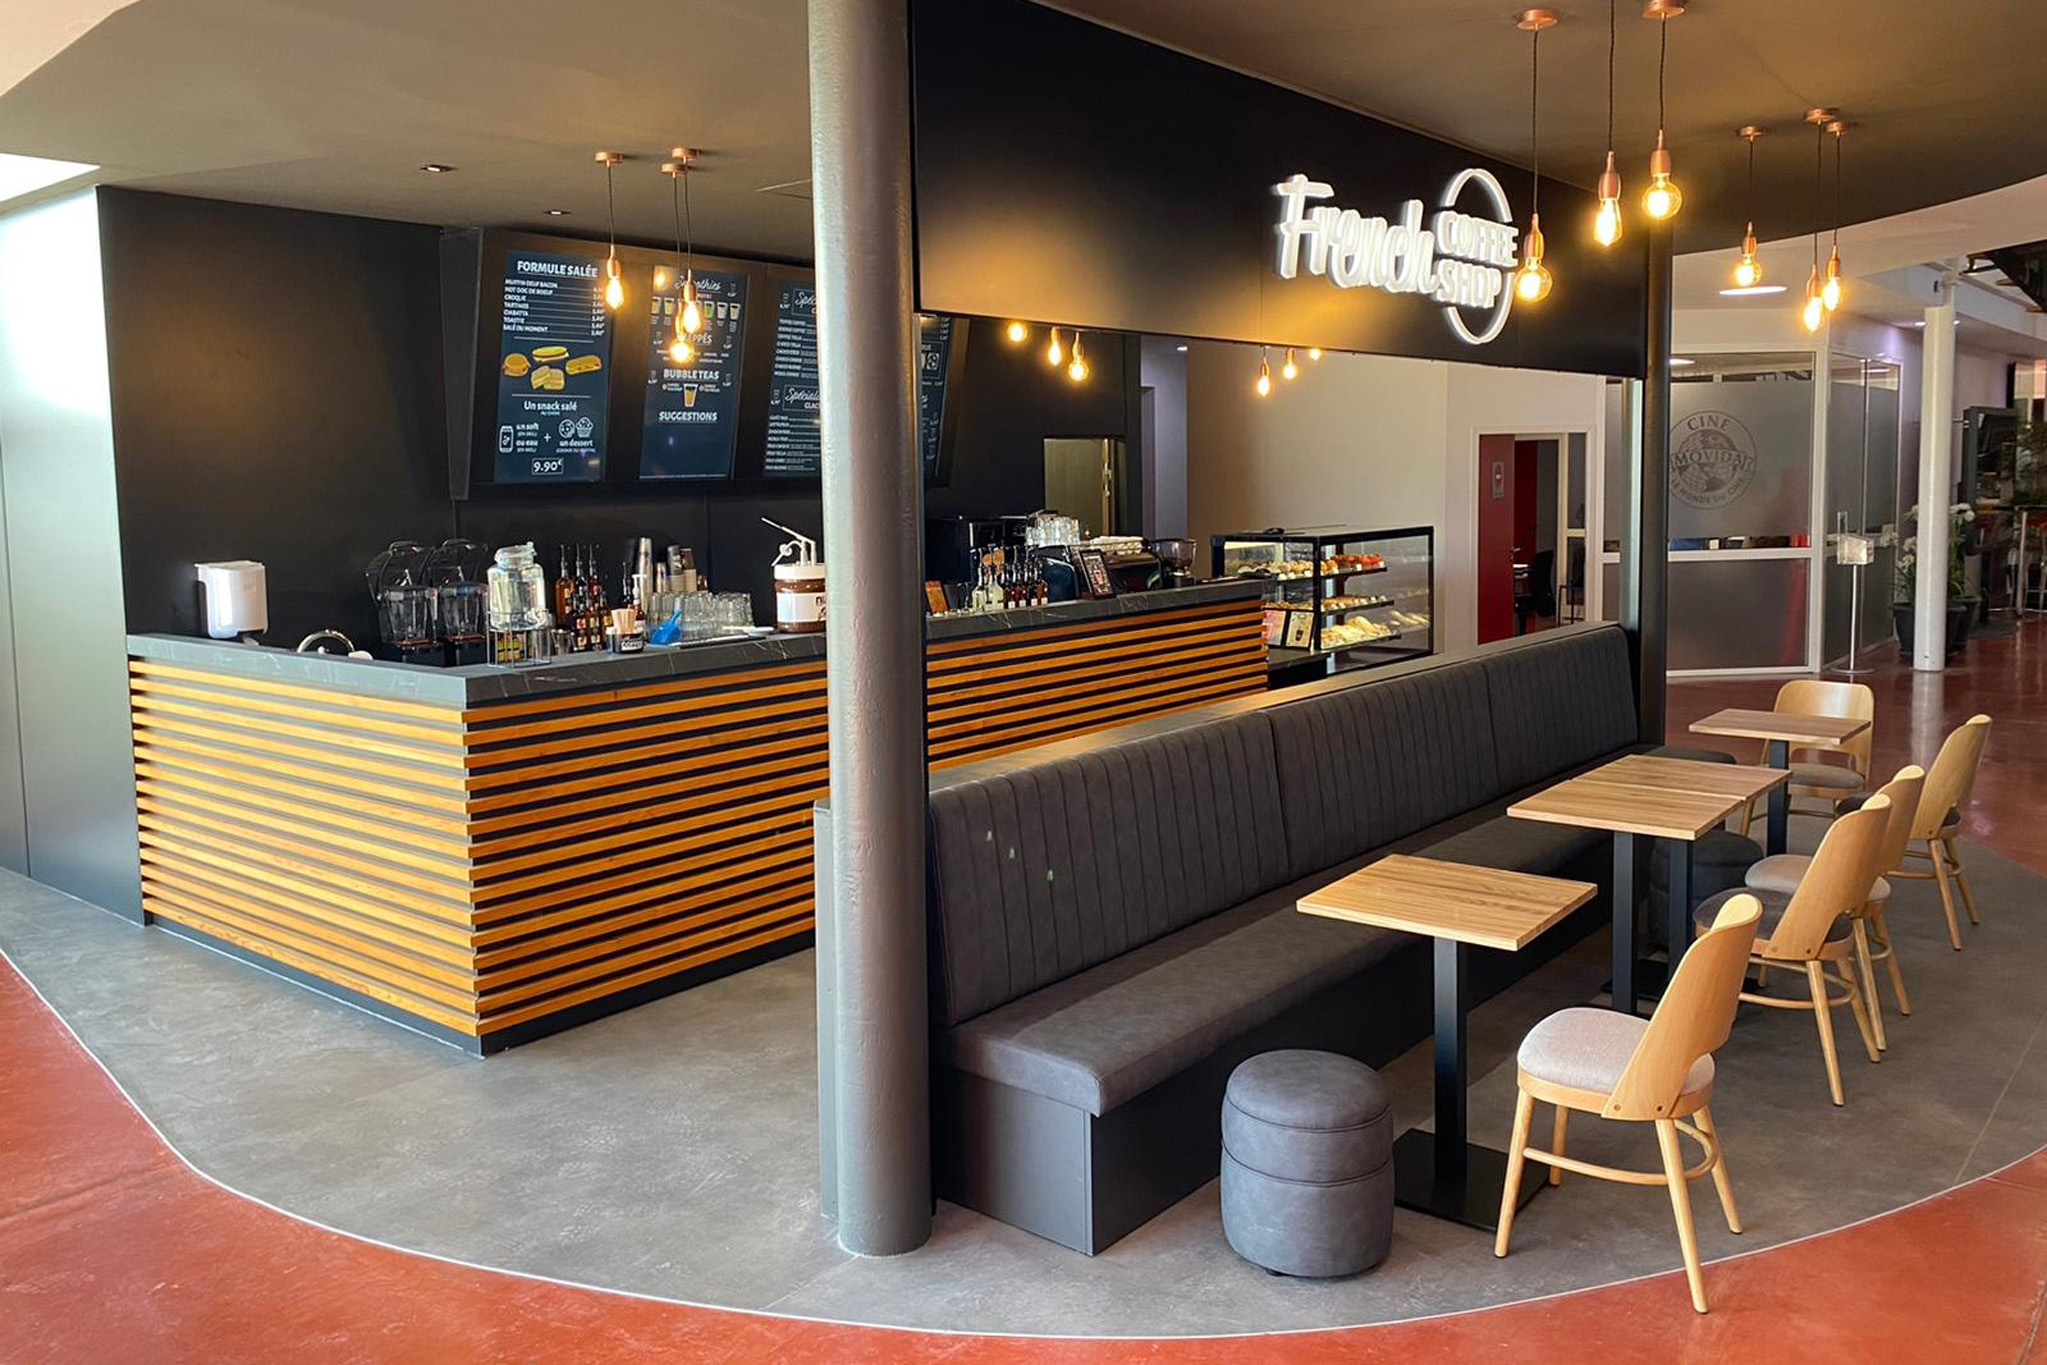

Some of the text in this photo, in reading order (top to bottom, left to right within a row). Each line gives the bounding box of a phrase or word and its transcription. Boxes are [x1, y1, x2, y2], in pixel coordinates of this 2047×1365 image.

[1270, 173, 1439, 295] French
[1436, 210, 1519, 268] COFFEE
[517, 260, 598, 278] FORMULE SALÉE
[1437, 259, 1504, 309] SHOP
[663, 368, 720, 380] BUBBLE TEAS
[523, 400, 578, 412] Un snack salé
[658, 411, 718, 421] SUGGESTIONS
[1687, 415, 1731, 431] CINE
[526, 422, 540, 431] soft
[569, 439, 593, 448] dessert
